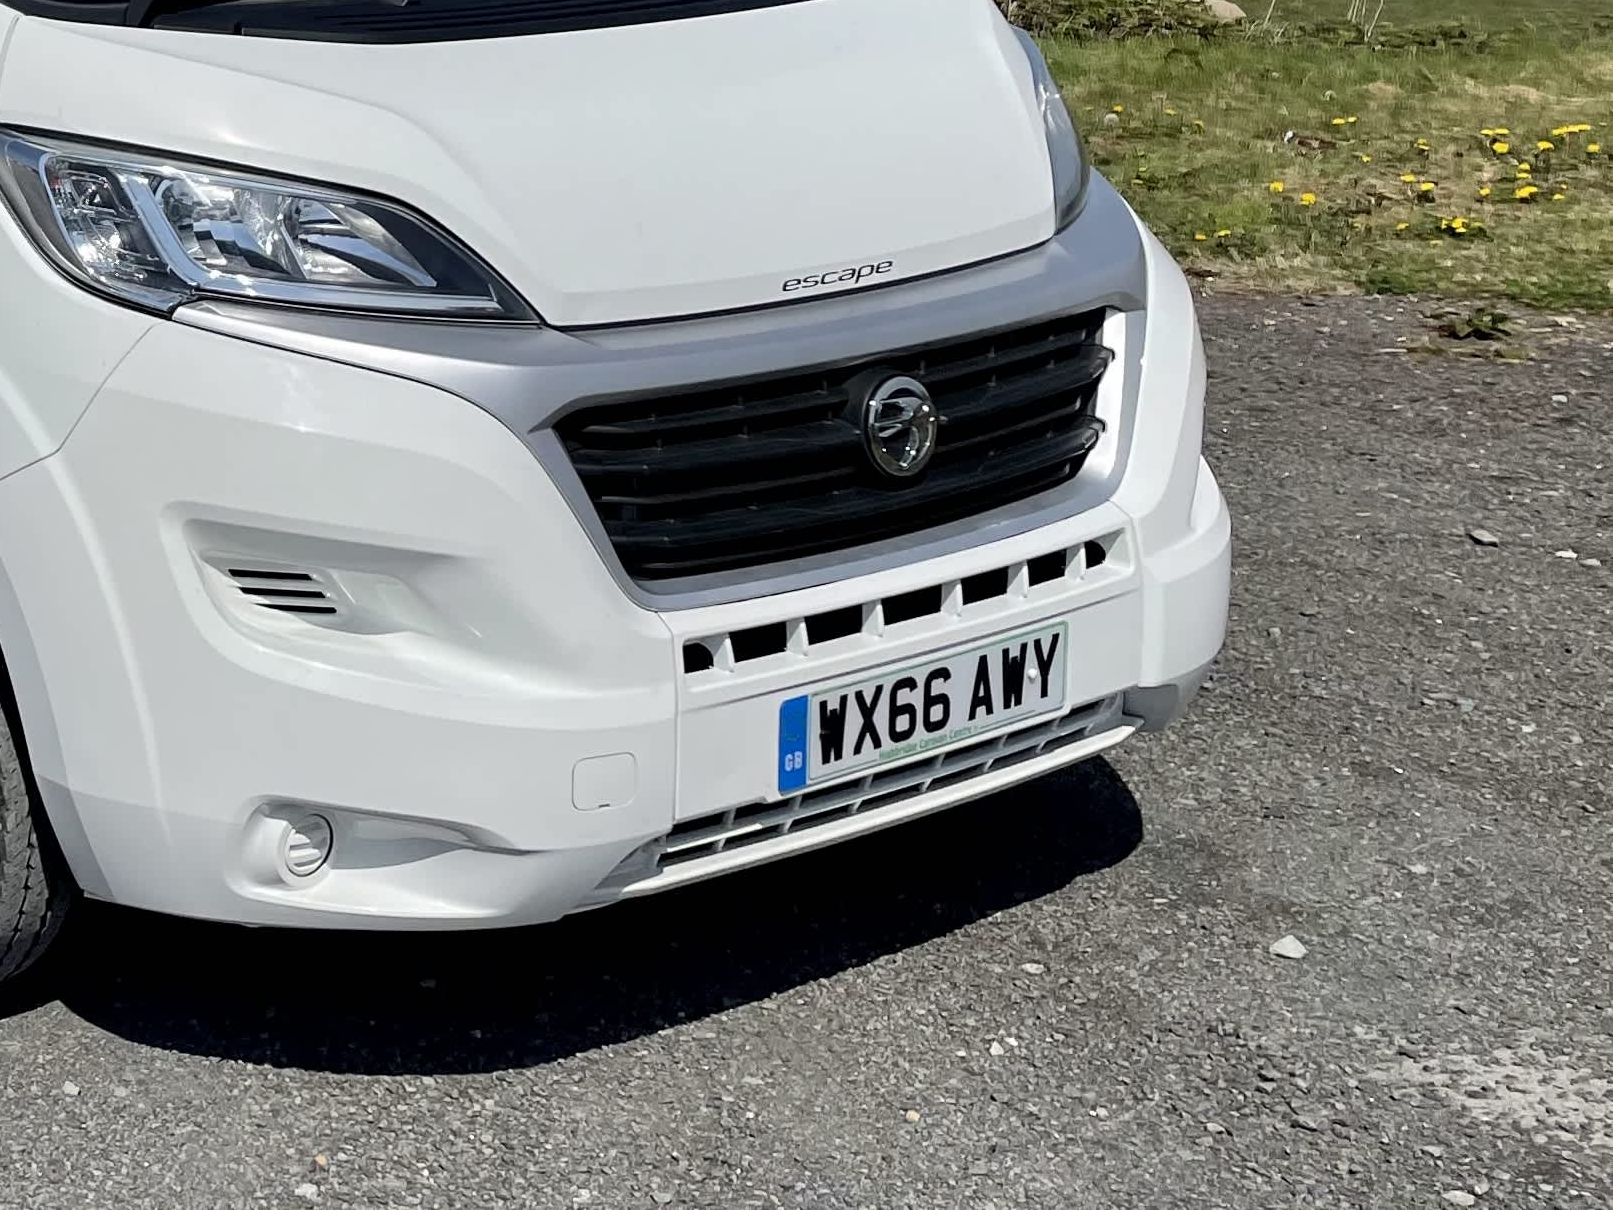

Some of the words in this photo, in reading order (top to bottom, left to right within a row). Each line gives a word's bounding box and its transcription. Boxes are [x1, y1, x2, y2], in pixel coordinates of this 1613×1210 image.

[782, 260, 893, 291] escape
[818, 666, 952, 766] WX66
[968, 633, 1060, 721] AWY
[784, 750, 804, 772] GB
